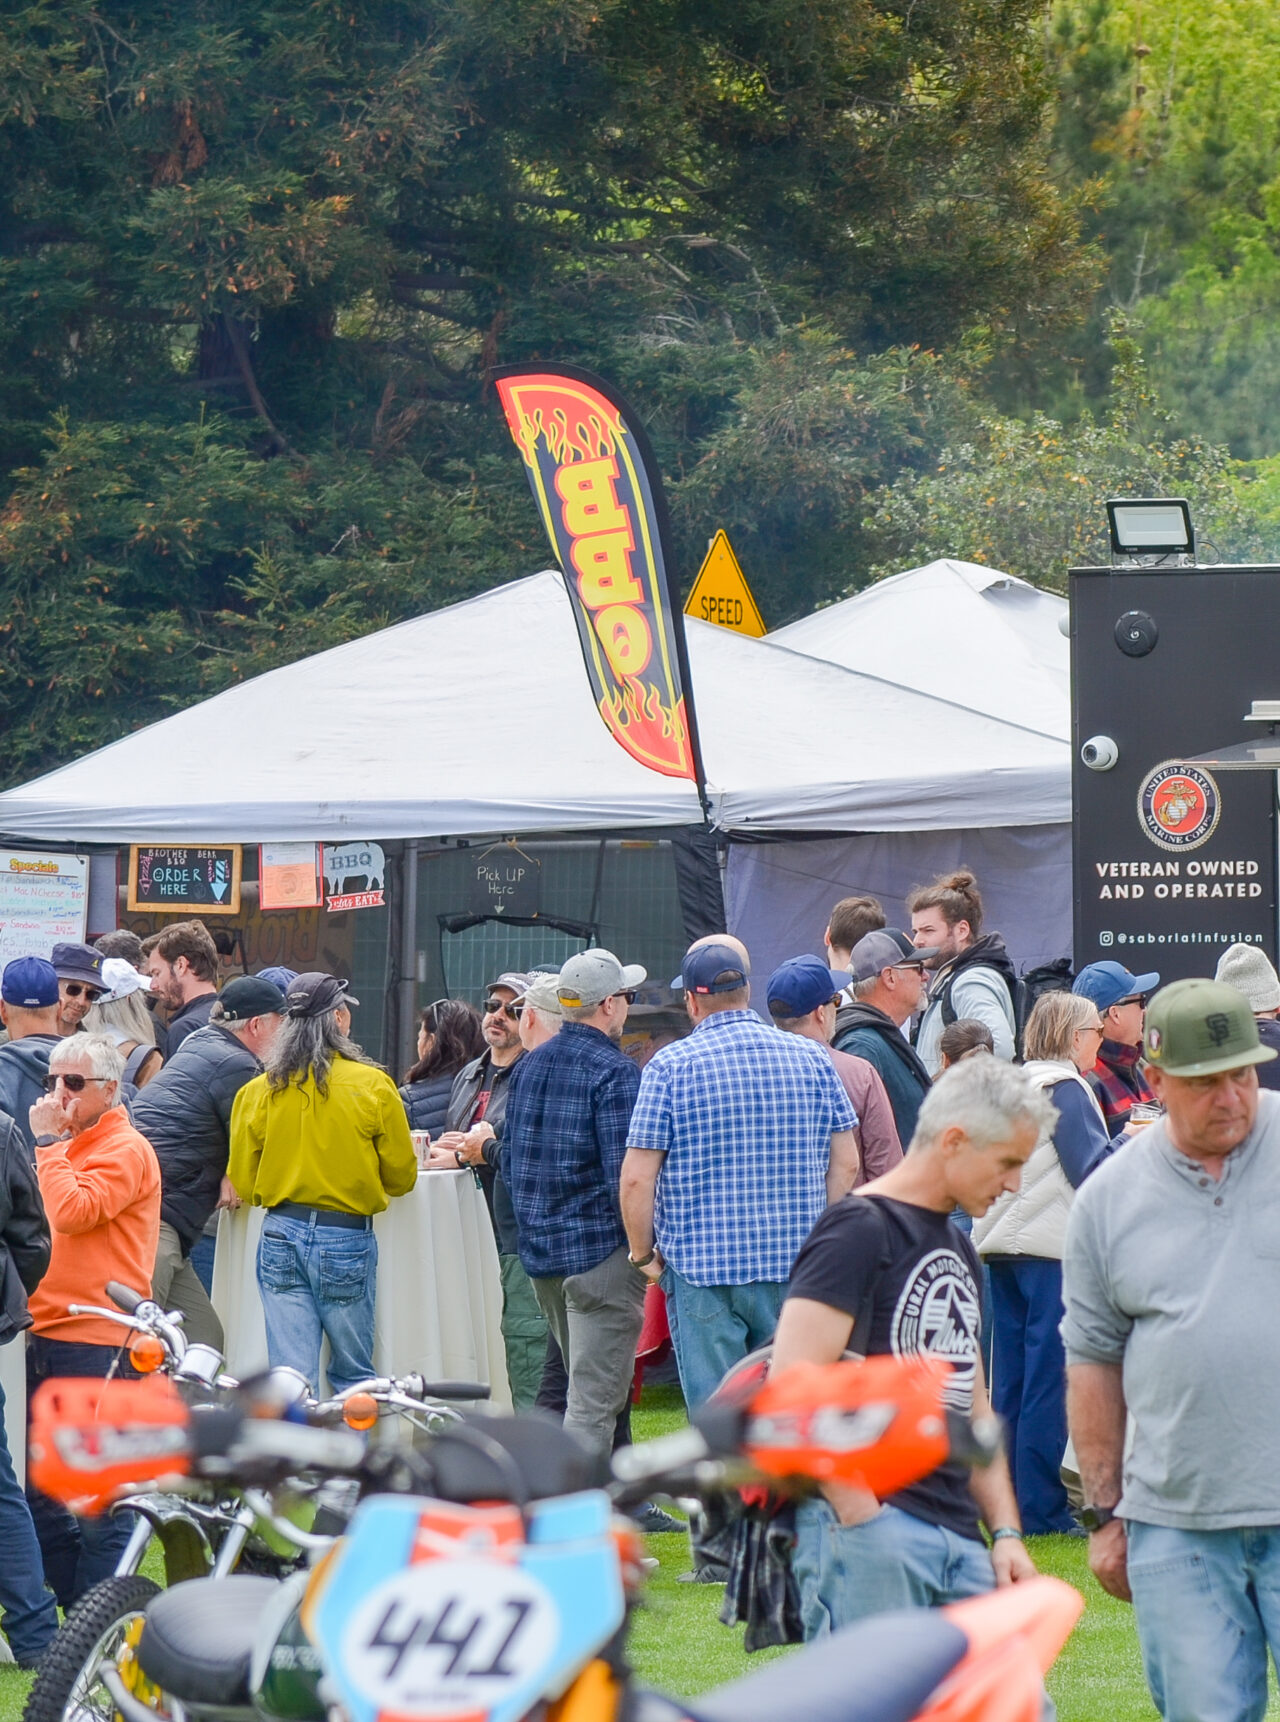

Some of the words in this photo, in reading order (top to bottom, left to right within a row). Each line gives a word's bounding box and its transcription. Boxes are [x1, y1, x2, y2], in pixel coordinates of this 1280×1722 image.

[701, 596, 743, 625] SPEED
[1145, 767, 1178, 798] UNITED
[1179, 767, 1212, 797] STATES
[1146, 814, 1183, 844] MARINE
[1184, 814, 1212, 842] CORPS
[148, 849, 188, 858] BROTHER
[197, 850, 217, 859] BEAR
[329, 852, 372, 870] BBQ
[10, 858, 59, 874] Specials
[477, 866, 501, 880] Pick
[1096, 862, 1180, 877] VETERAN
[1186, 861, 1259, 876] OWNED
[153, 868, 202, 881] ORDER
[160, 884, 188, 895] HERE
[488, 882, 515, 894] Here
[1099, 884, 1145, 899] AND
[1154, 883, 1262, 898] OPERATED
[1117, 932, 1263, 944] @saborlatinfusion
[905, 1277, 930, 1317] URAL
[368, 1598, 535, 1679] 441
